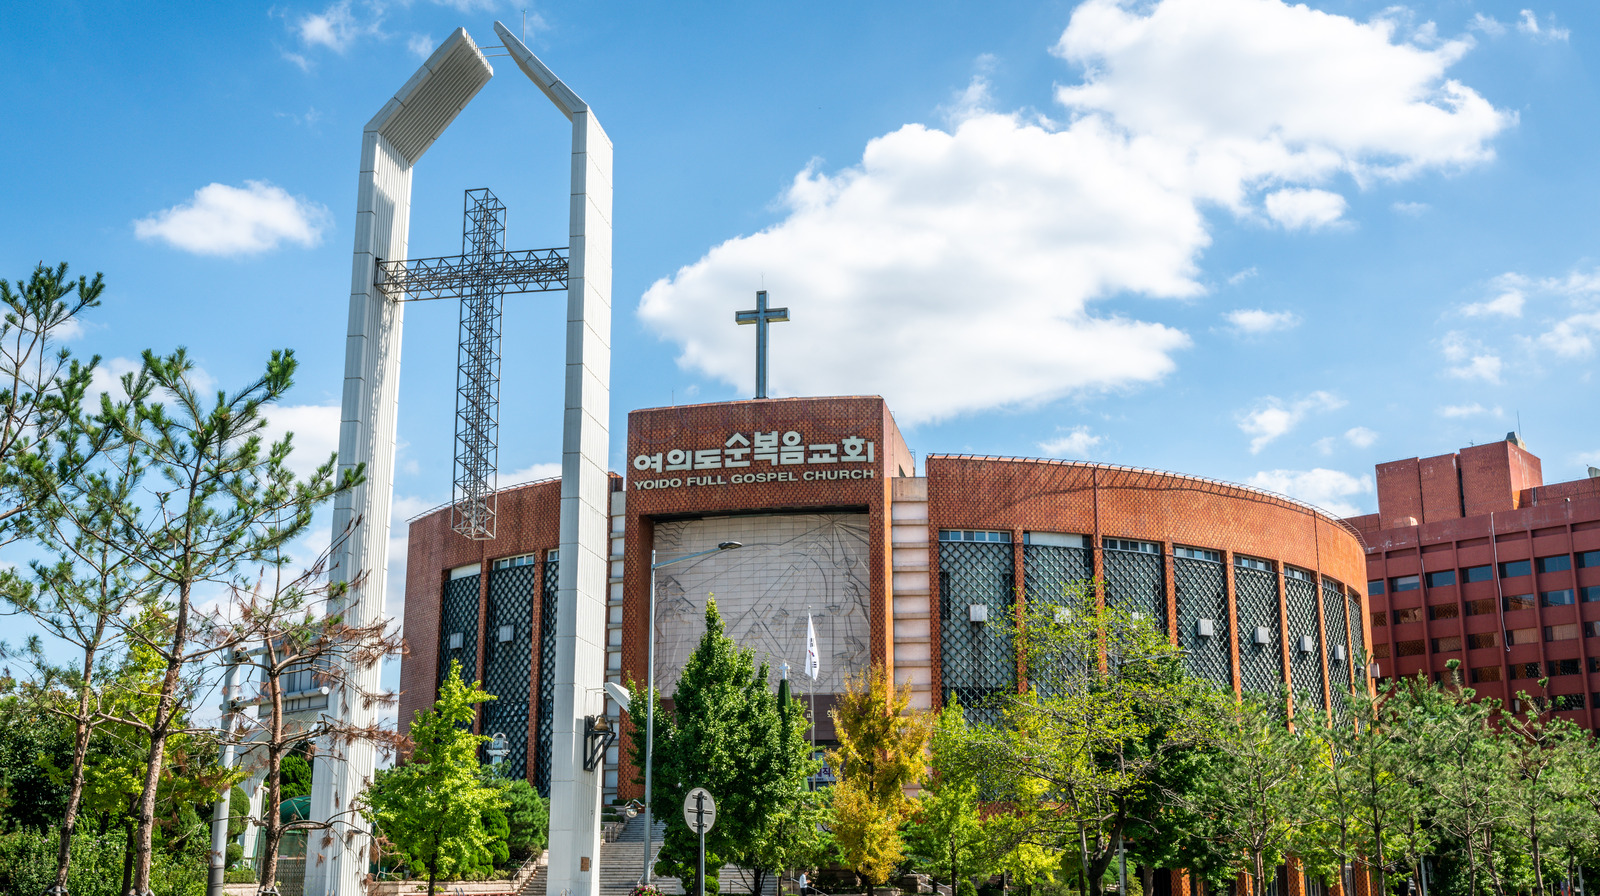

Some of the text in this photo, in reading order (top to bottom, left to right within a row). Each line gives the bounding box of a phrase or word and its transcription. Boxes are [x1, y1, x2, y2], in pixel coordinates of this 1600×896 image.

[633, 430, 875, 473] 여의도순복음교회
[634, 469, 874, 490] YOIDO FULL GOSPEL CHURCH
